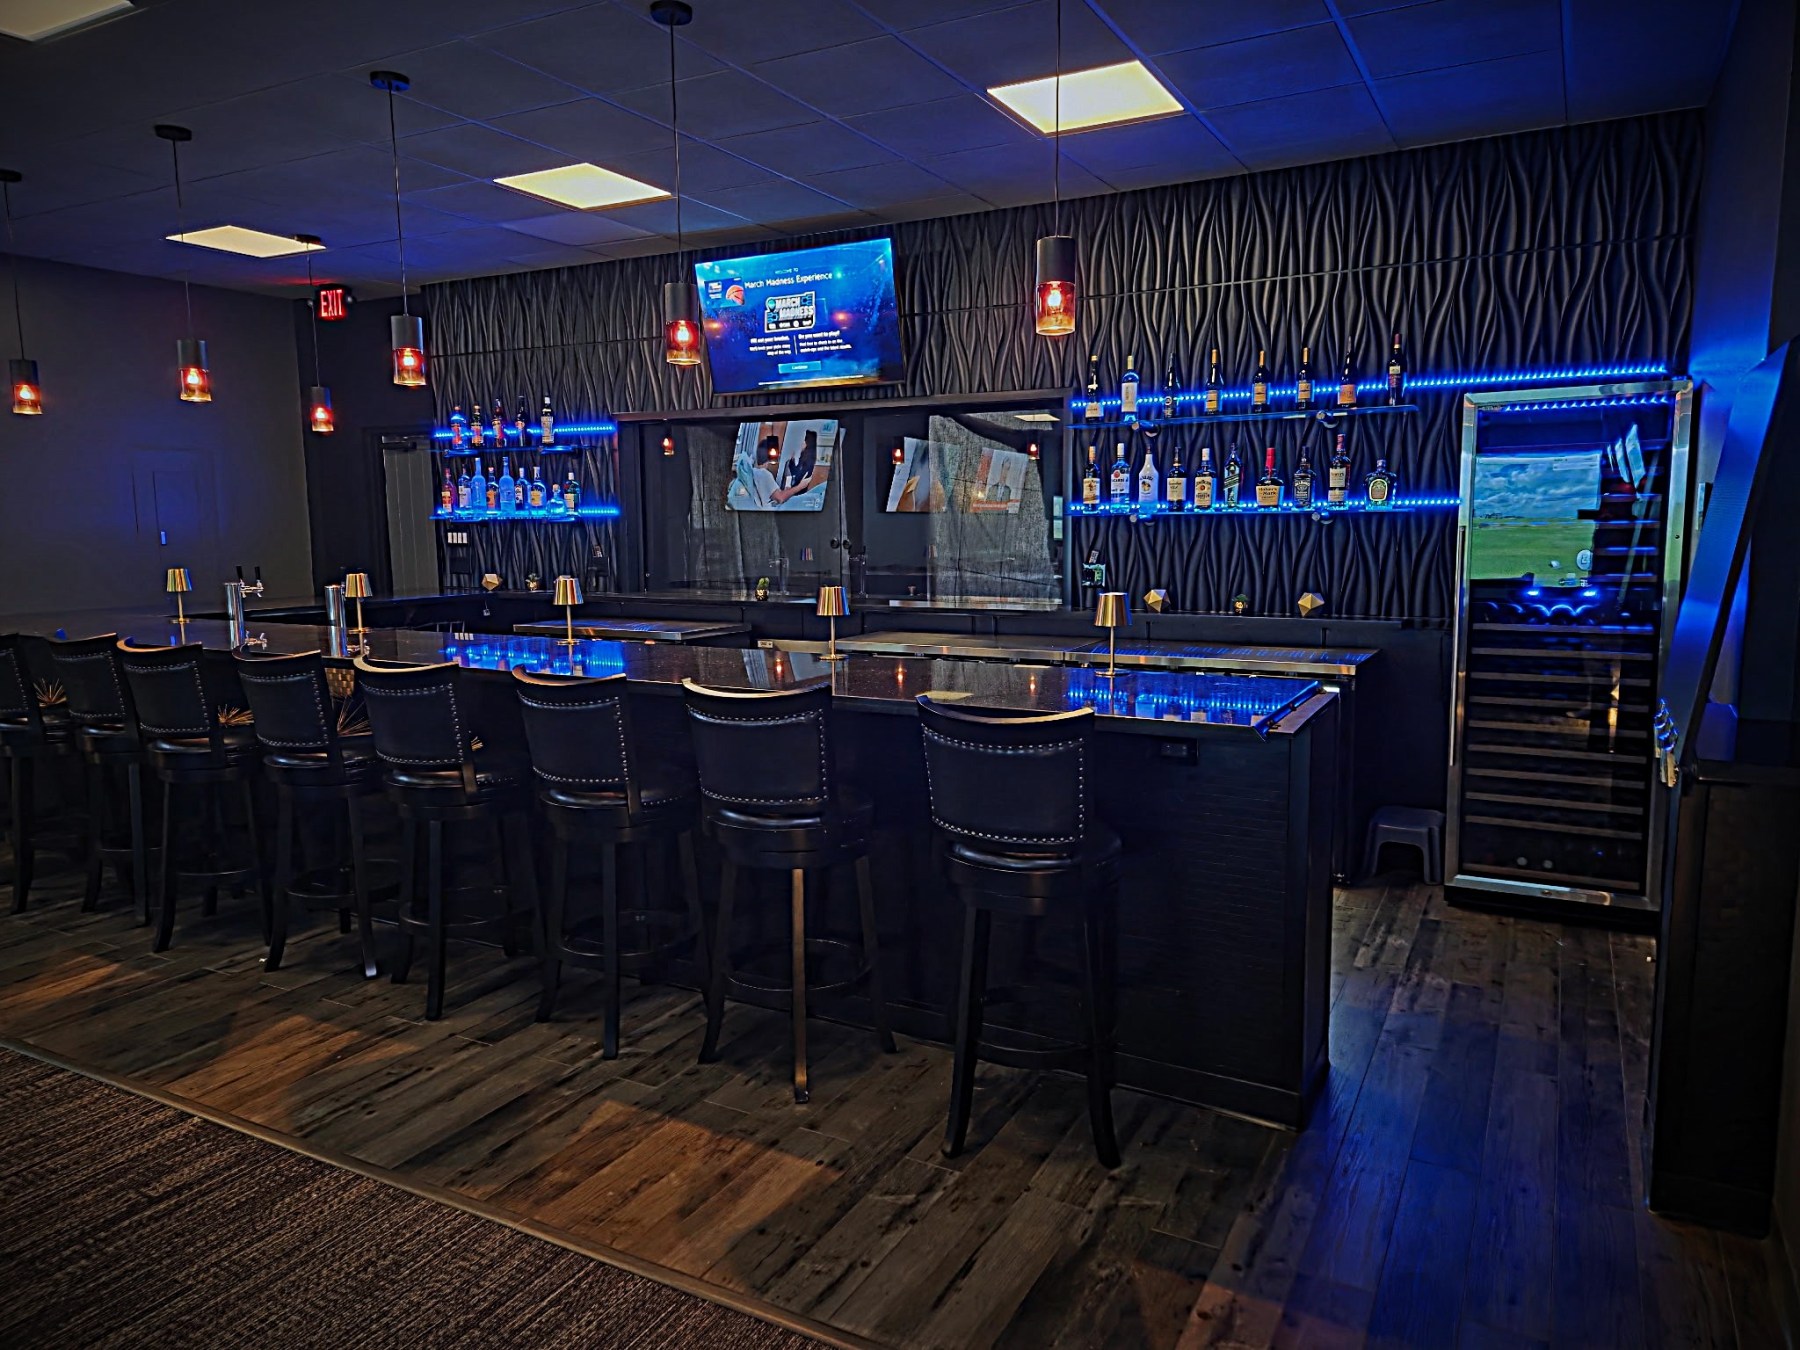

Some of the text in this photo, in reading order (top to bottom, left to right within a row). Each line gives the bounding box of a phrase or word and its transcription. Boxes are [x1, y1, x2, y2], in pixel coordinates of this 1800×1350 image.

[744, 272, 833, 289] March Madness Experience
[320, 289, 343, 317] EXIT
